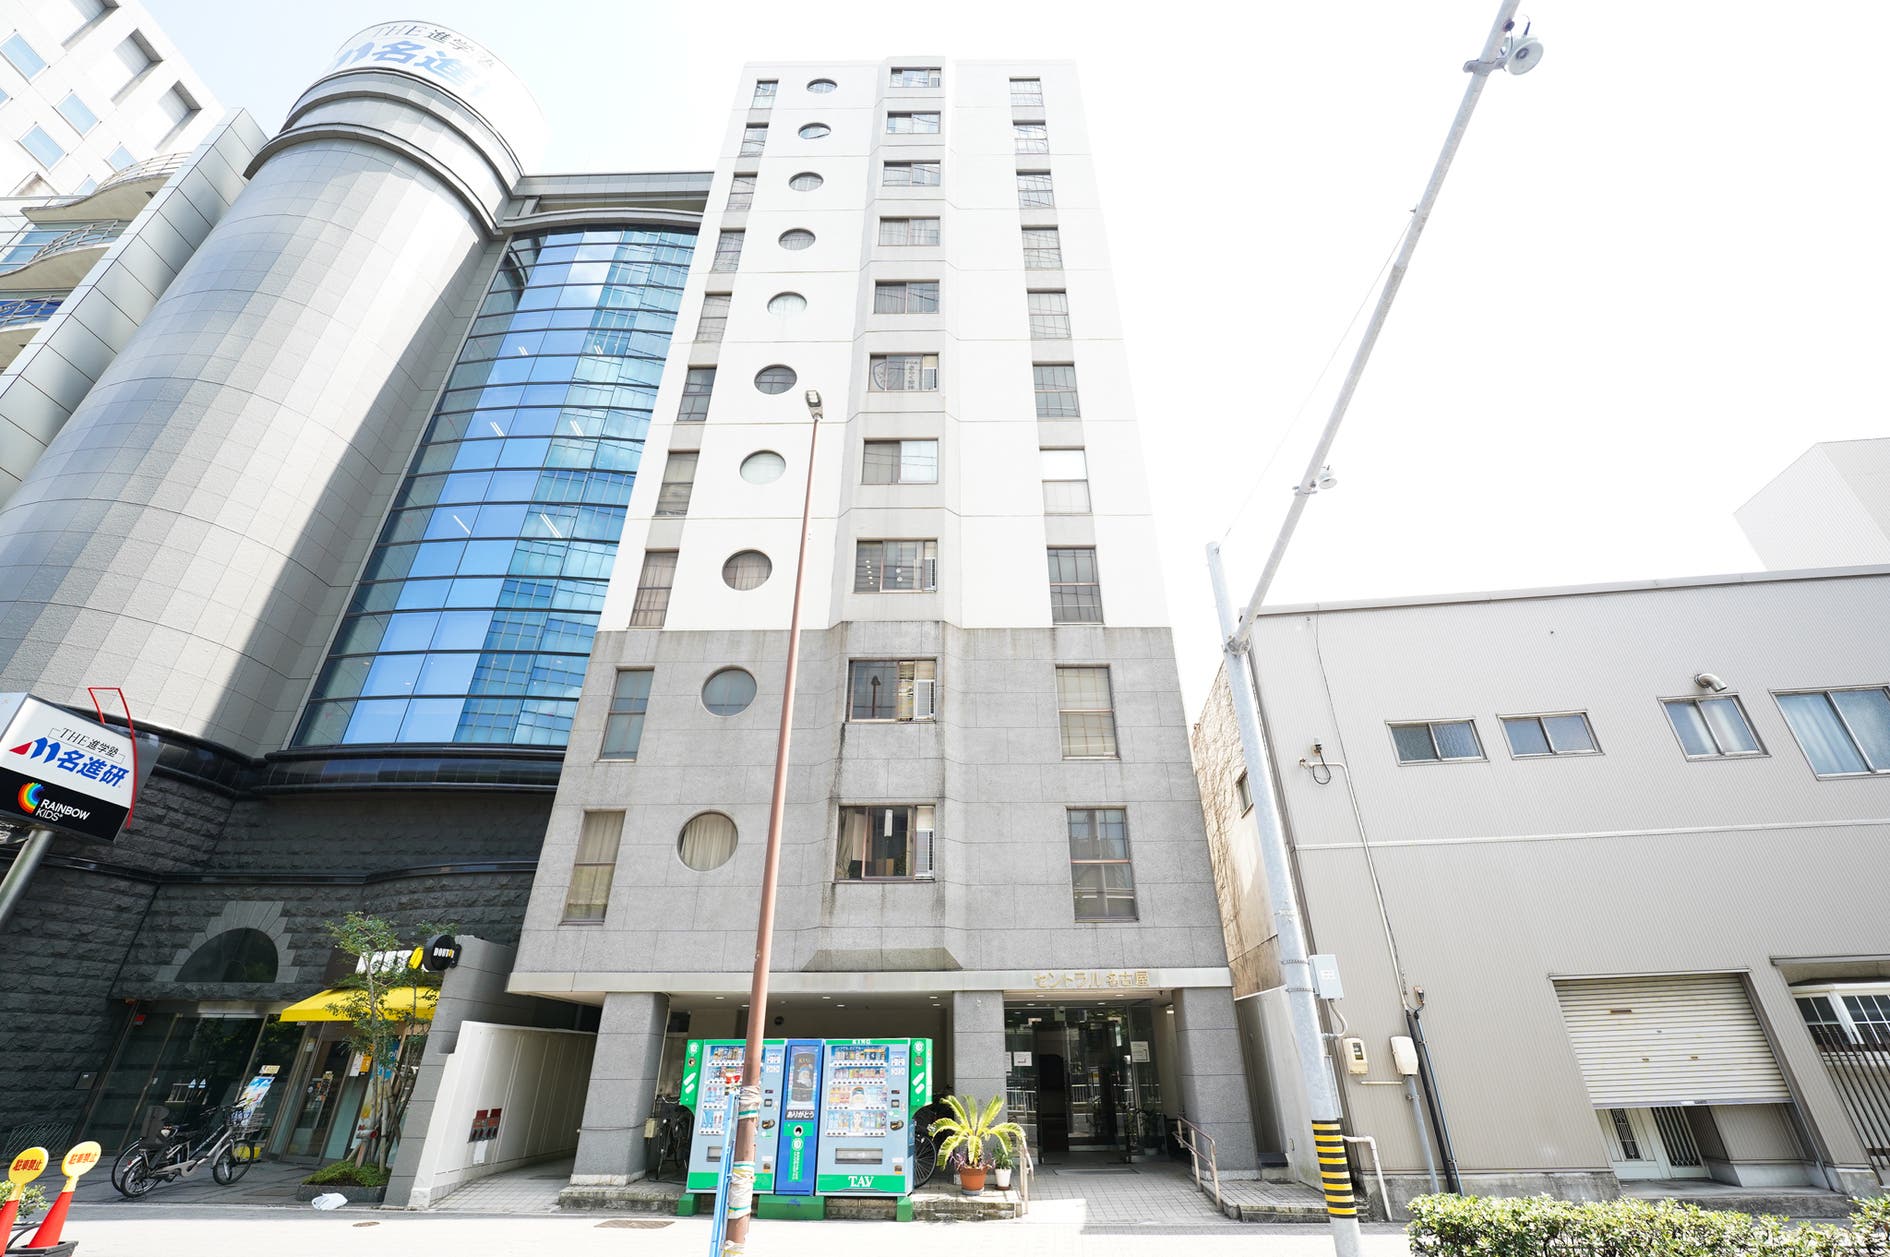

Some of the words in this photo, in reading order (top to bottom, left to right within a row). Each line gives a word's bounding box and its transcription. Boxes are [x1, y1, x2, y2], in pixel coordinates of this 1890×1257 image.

[59, 727, 90, 746] THE
[87, 737, 120, 758] 進学塾
[57, 749, 130, 787] 名進研
[35, 808, 60, 823] KIDS
[40, 799, 91, 821] RAINBOW
[1033, 970, 1150, 989] セントラル名古屋
[786, 1110, 815, 1119] ありがとう
